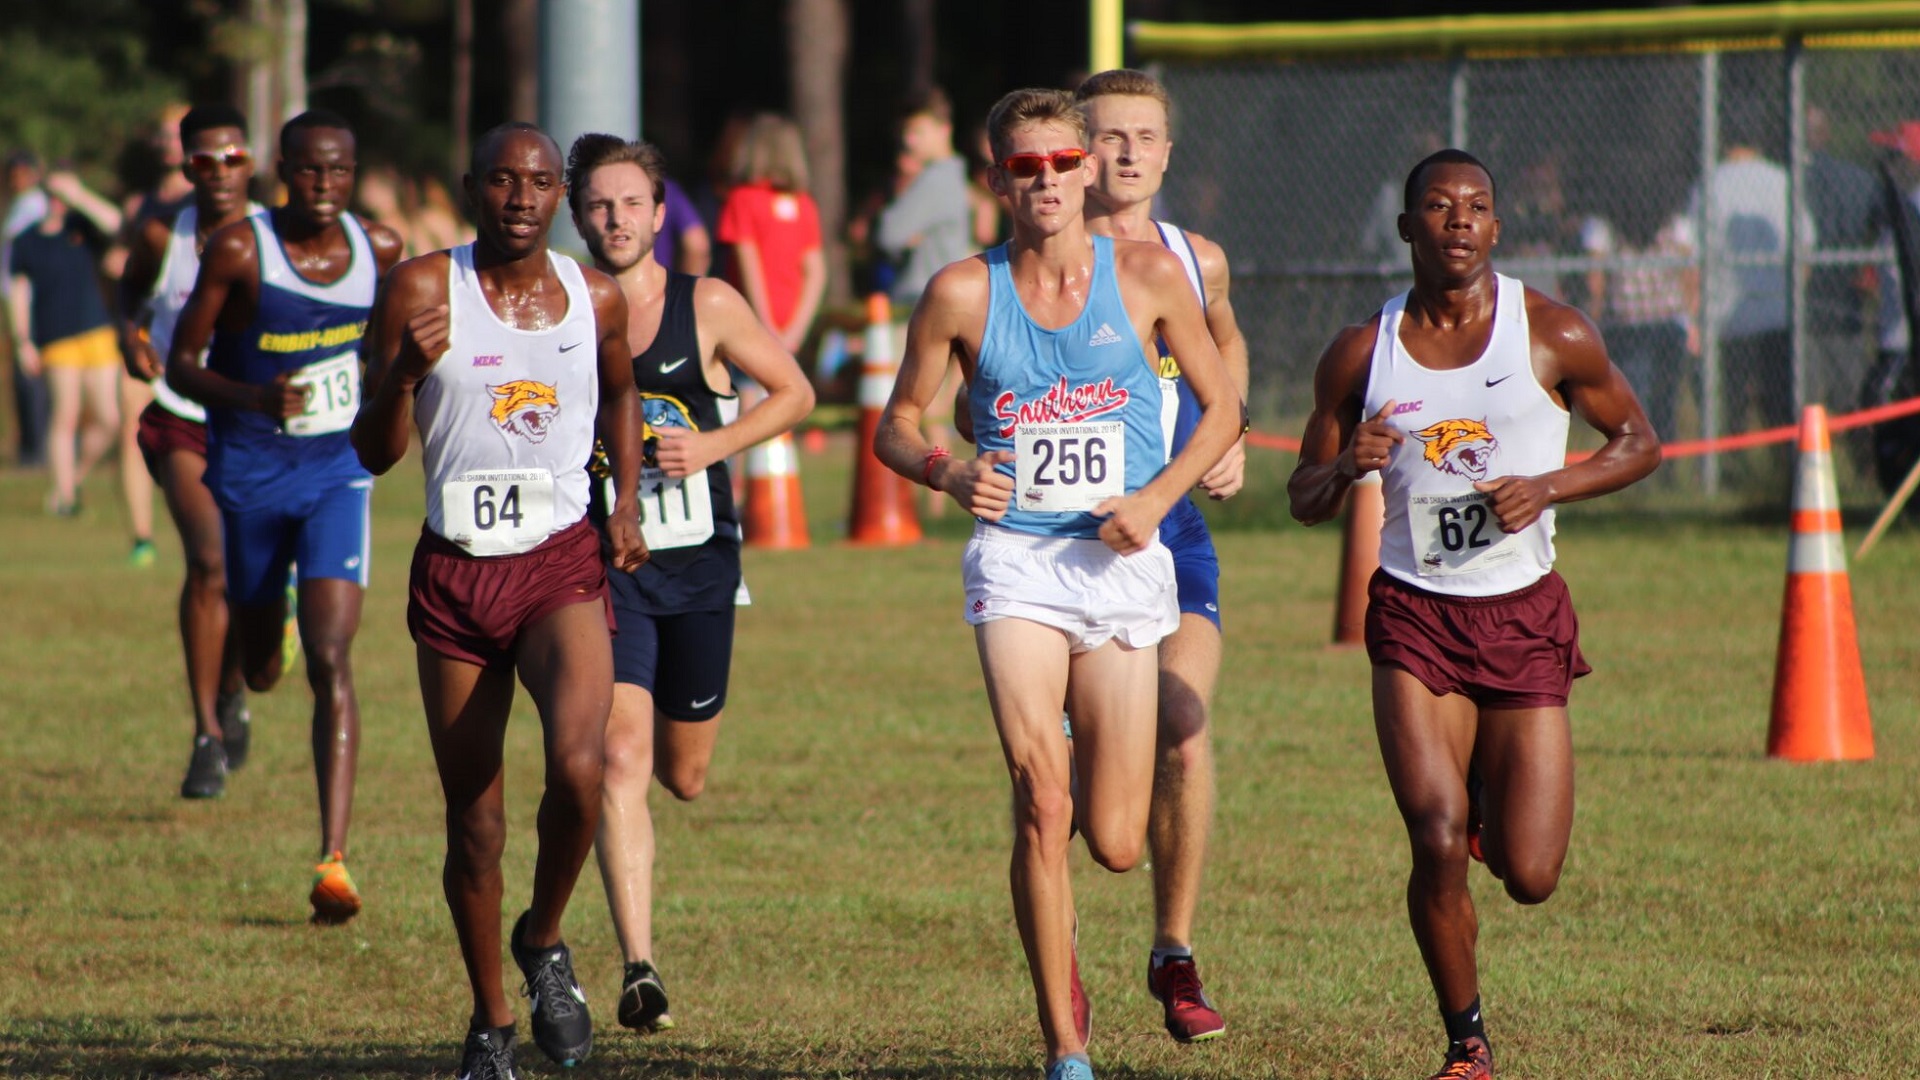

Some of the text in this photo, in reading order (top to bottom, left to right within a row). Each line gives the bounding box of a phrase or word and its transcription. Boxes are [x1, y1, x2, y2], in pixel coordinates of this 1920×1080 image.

[472, 355, 504, 367] MEAC
[303, 369, 352, 416] 213
[995, 375, 1129, 438] Southern
[1021, 425, 1117, 435] SAND SHARK INVITATIONAL 2018
[487, 473, 528, 481] INVITATIONAL
[1033, 437, 1107, 486] 256
[473, 485, 524, 530] 64
[1412, 497, 1428, 505] SAND
[1429, 496, 1449, 505] SHARK
[1439, 504, 1491, 551] 62
